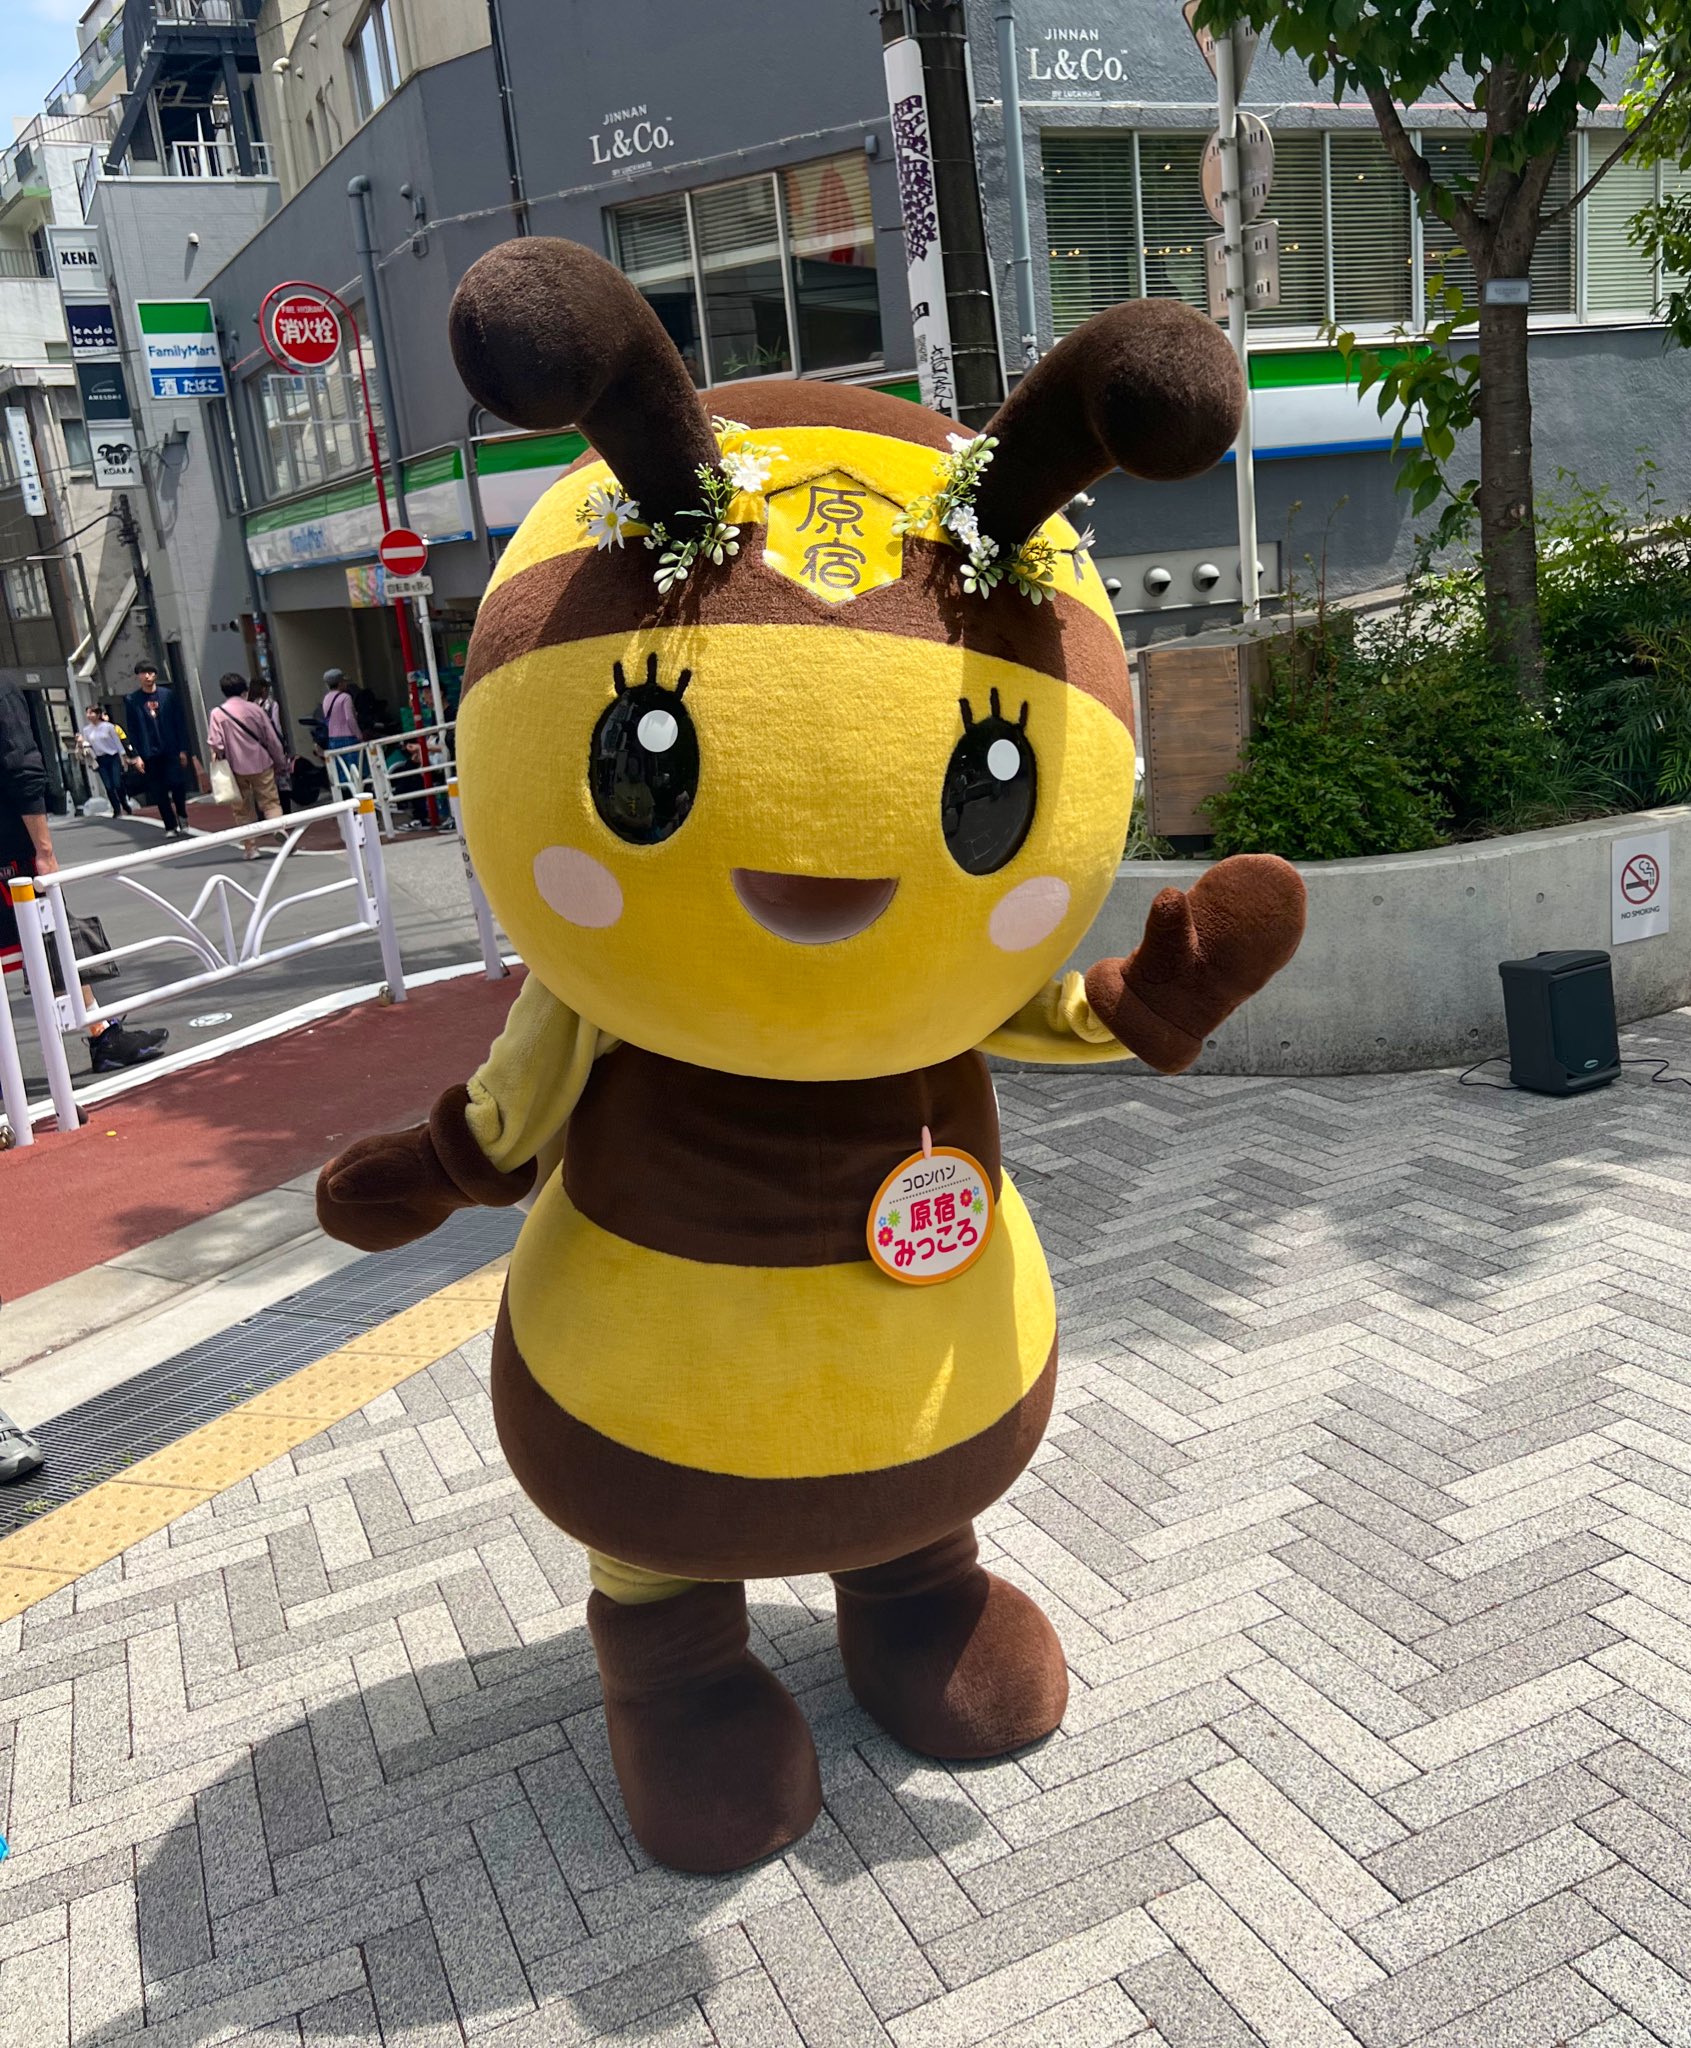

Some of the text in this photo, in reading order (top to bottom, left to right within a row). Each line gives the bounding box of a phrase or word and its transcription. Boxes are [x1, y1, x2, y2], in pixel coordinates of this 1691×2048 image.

[1044, 28, 1099, 41] JINNAN
[1025, 47, 1129, 81] L&Co.
[602, 104, 648, 126] JINNAN
[588, 121, 675, 165] L&Co.
[60, 251, 98, 265] XENA
[279, 317, 336, 344] 消火栓
[148, 345, 216, 359] FamilyMart
[159, 378, 219, 395] 酒 たばこ
[103, 466, 135, 475] KOARA
[796, 485, 867, 589] 原宿
[1620, 905, 1660, 920] NO SMOKING
[910, 1192, 955, 1233] 原宿
